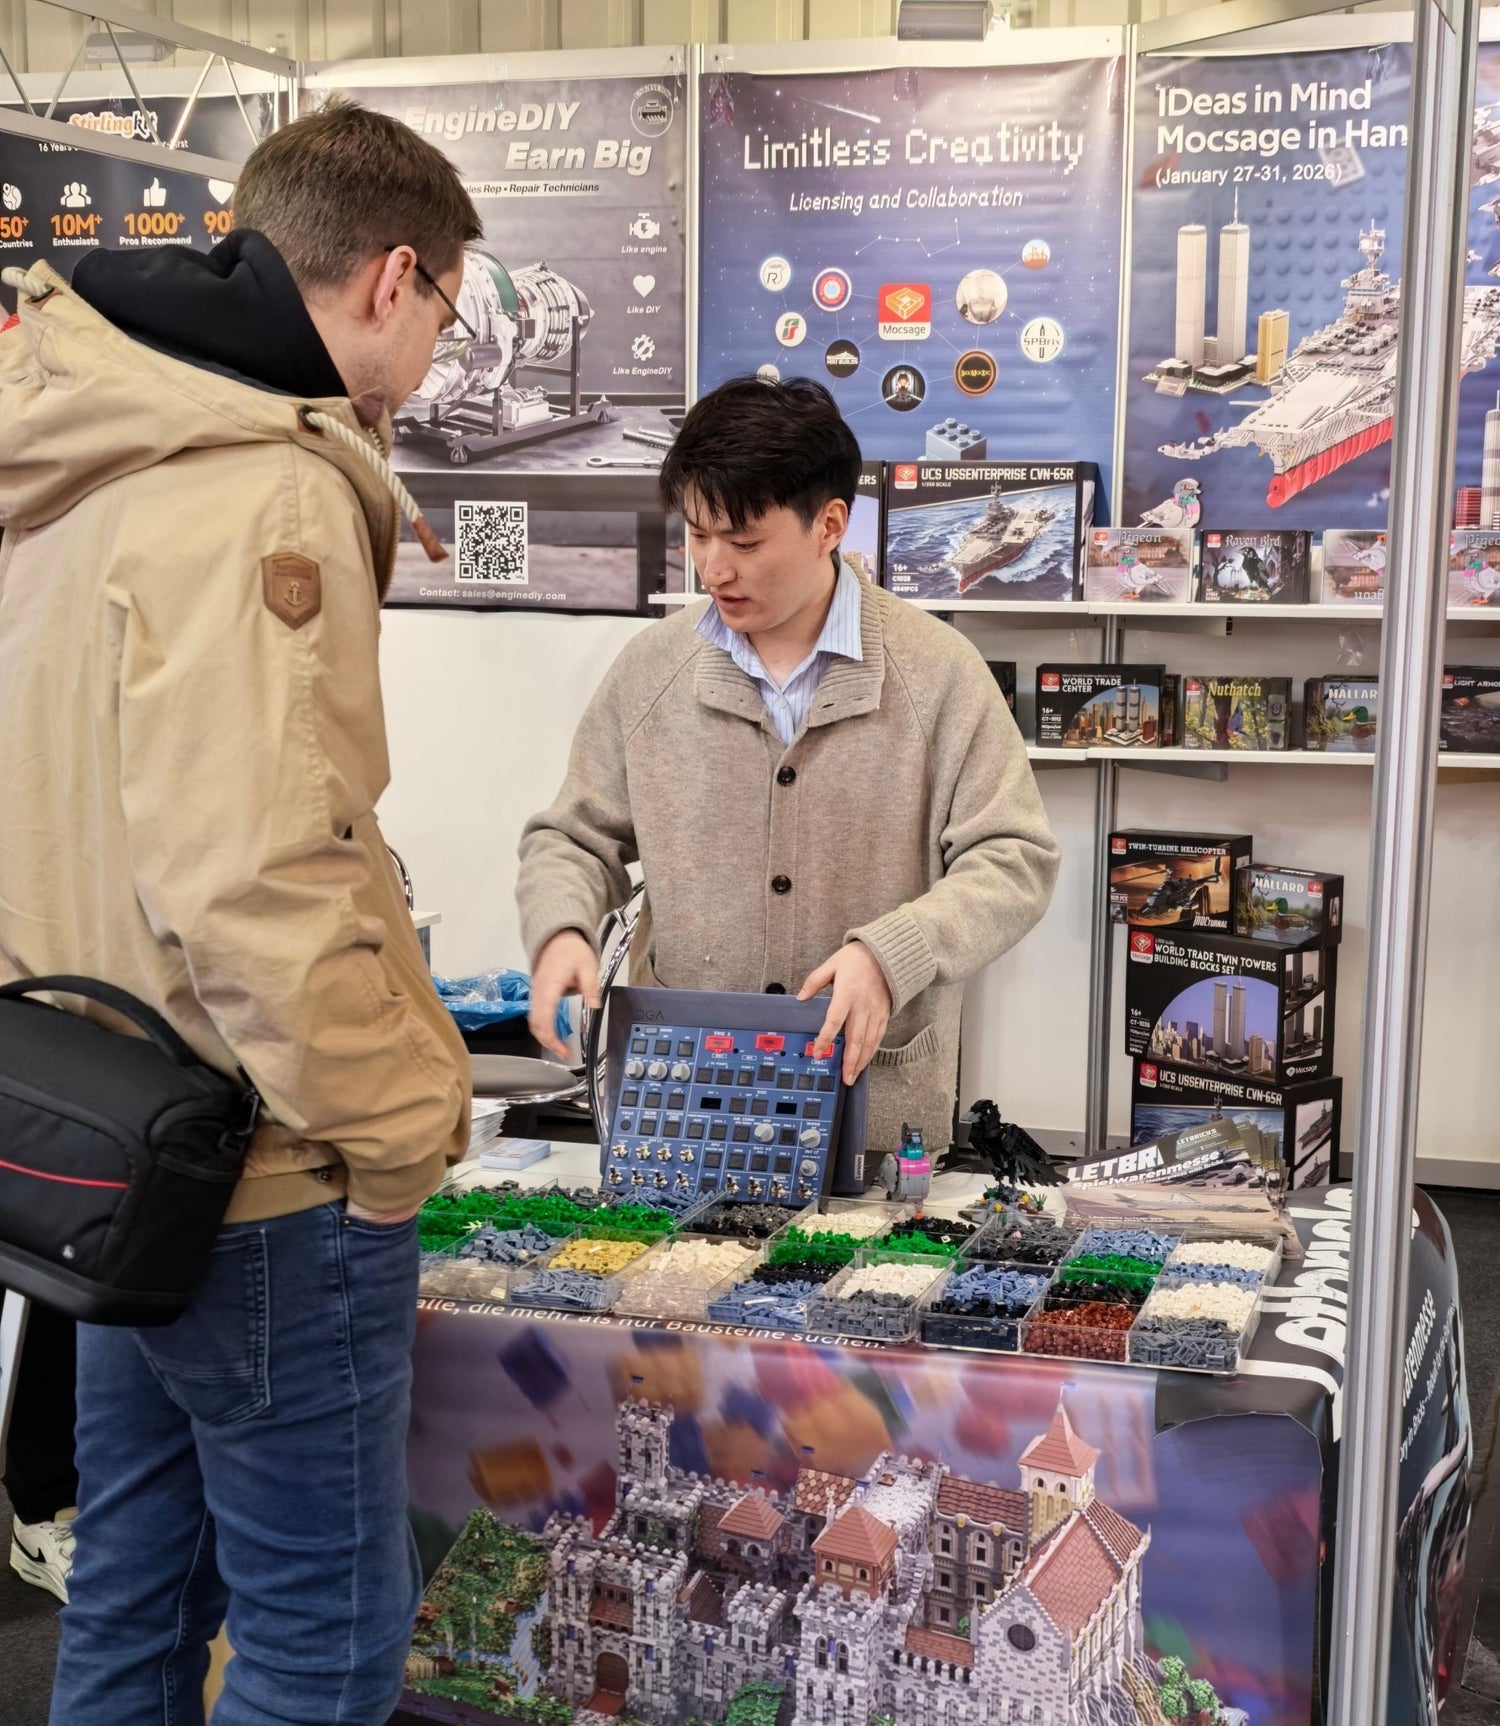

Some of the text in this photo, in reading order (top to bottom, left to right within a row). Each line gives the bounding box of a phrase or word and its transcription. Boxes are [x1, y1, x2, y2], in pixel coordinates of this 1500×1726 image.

[1254, 84, 1282, 113] in
[1290, 79, 1372, 113] Mind
[404, 102, 581, 141] EngineDIY
[1157, 119, 1409, 157] Mocsage in Han
[743, 120, 1084, 175] Limitless Creativity
[504, 138, 653, 177] Earn Big
[1155, 163, 1343, 188] (January 27-31, 2026)
[483, 184, 502, 194] Rep
[509, 183, 541, 194] Repair
[543, 182, 599, 193] Technicians
[789, 185, 1023, 216] Licensing and Collaboration
[51, 213, 103, 236] 10M+
[124, 211, 186, 235] 1000+
[52, 237, 100, 247] Enthusiasts
[119, 235, 192, 246] Pros Recommend
[621, 245, 667, 255] Like engine
[627, 305, 660, 314] Like DIY
[883, 324, 926, 336] Mocsage
[613, 366, 673, 377] Like EngineDIY
[921, 467, 1074, 481] UCS USSENTERPRISE CVN-65R
[1226, 533, 1281, 547] Raven Bird
[419, 587, 567, 601] Contact: sales@enginediy.com
[1062, 677, 1122, 686] WORLD TRADE
[1062, 685, 1092, 693] CENTER
[1208, 682, 1262, 697] Nuthatch
[1328, 688, 1378, 699] MALLAR
[1180, 847, 1226, 855] HELICOPTER
[1255, 877, 1305, 893] MALLARD
[1154, 953, 1235, 975] BUILDING BLOCKS SET
[1155, 943, 1277, 972] WORLD TRADE TWIN TOWERS
[1159, 1069, 1283, 1106] UCS USSENTERPRISE CVN-65R
[1067, 1144, 1165, 1183] LETBRI
[468, 1301, 505, 1315] die
[510, 1306, 570, 1321] mehr
[618, 1317, 661, 1330] nur
[666, 1320, 785, 1340] Bausteine
[792, 1333, 886, 1350] suchen.
